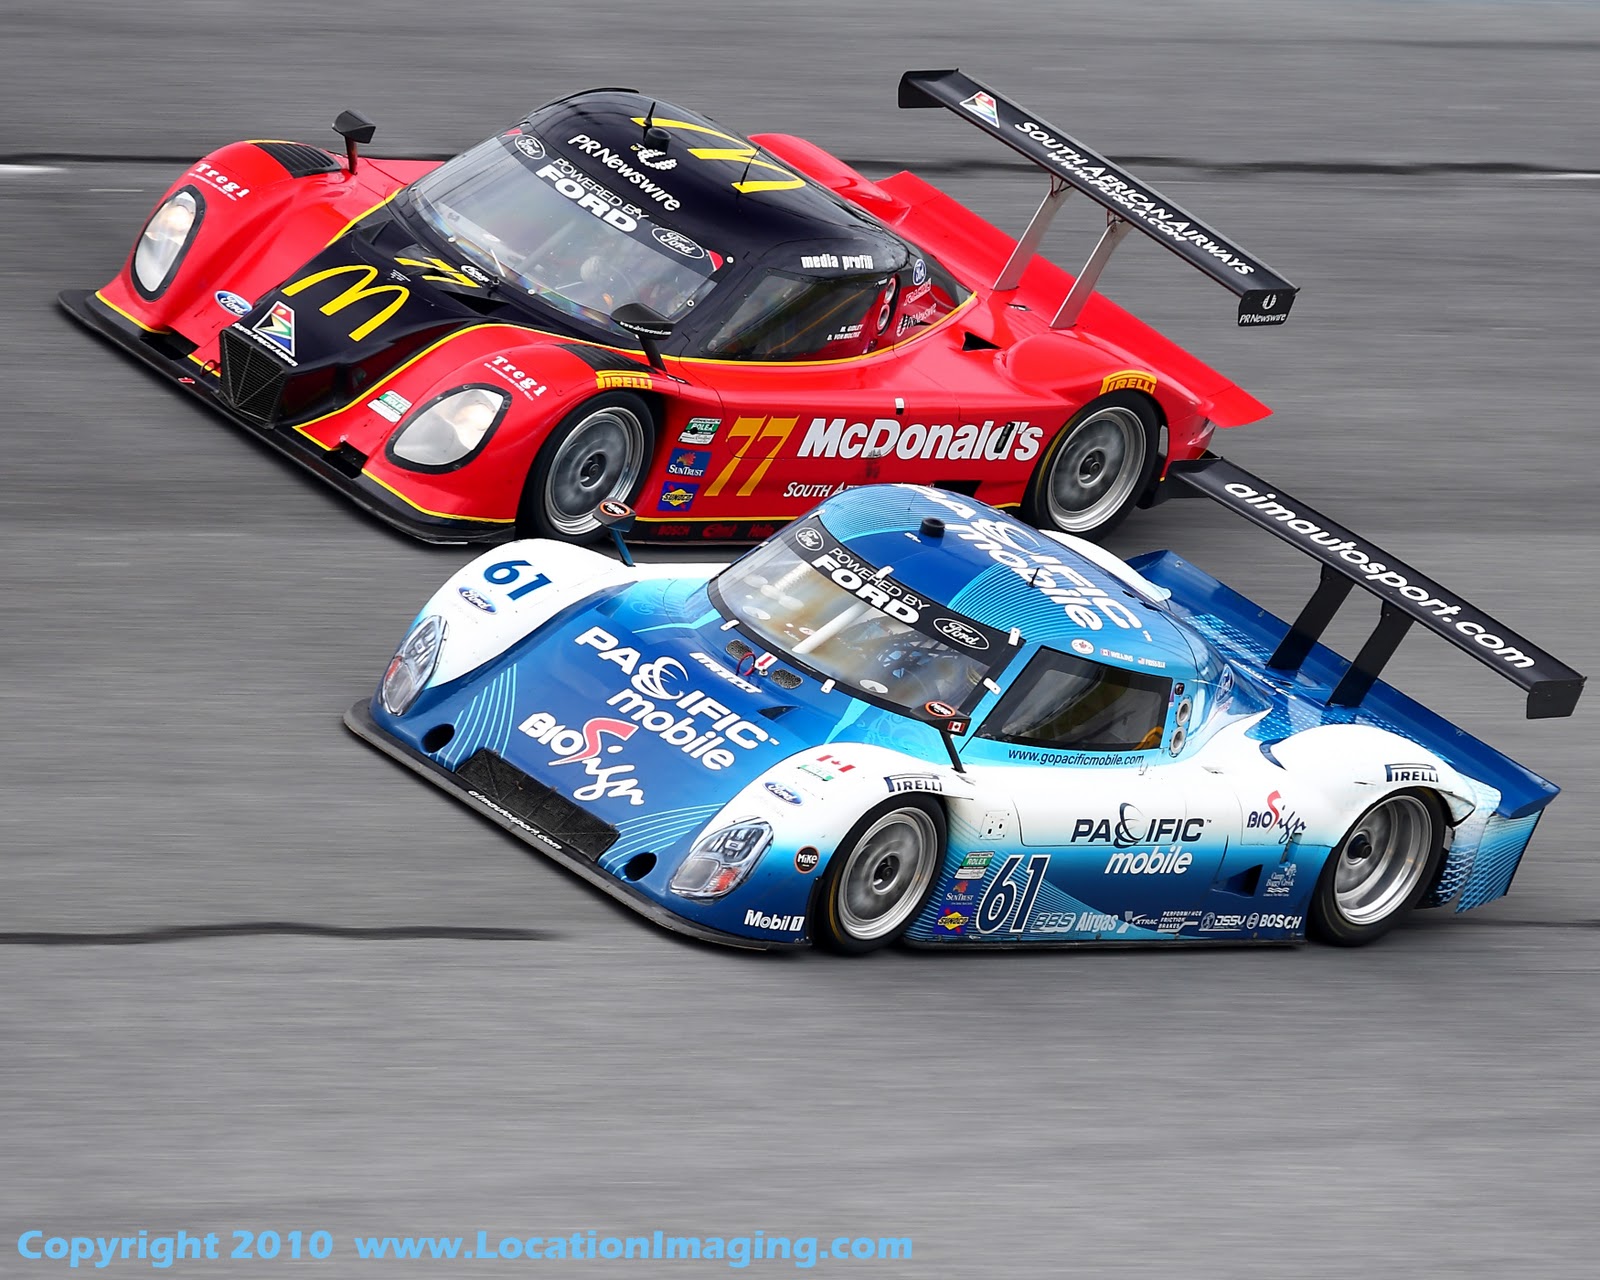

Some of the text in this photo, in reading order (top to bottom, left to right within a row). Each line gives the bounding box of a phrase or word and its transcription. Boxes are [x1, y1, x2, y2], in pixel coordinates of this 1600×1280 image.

[536, 164, 638, 233] FORD
[552, 157, 650, 221] POWERED BY
[1014, 121, 1255, 275] SOUTH AFRICAN AIRWAYS
[661, 231, 697, 257] Ford
[801, 254, 839, 269] media
[218, 295, 248, 316] Ford
[595, 369, 653, 390] PIRELLI
[1098, 369, 1158, 396] PIRELLI
[796, 417, 1044, 462] McDonald's
[703, 413, 801, 497] 77
[783, 481, 834, 498] SOUTH
[483, 559, 553, 601] 61
[829, 547, 931, 611] POWERED BY
[944, 523, 1104, 631] mobile
[1223, 479, 1537, 670] aimautosport.com
[460, 589, 493, 611] Ford
[811, 553, 920, 624] FORD
[942, 619, 981, 647] Ford
[606, 688, 735, 771] mobile
[1008, 747, 1145, 766] www.gopacificmobile.com
[883, 773, 943, 793] PIRELLI
[1384, 762, 1439, 783] PIRELLI
[766, 783, 799, 803] Ford
[1104, 845, 1194, 875] mobile
[975, 853, 1052, 935] 61
[743, 909, 805, 932] Mobil 1
[1075, 911, 1119, 932] Airgas
[1258, 913, 1302, 930] BOSCH
